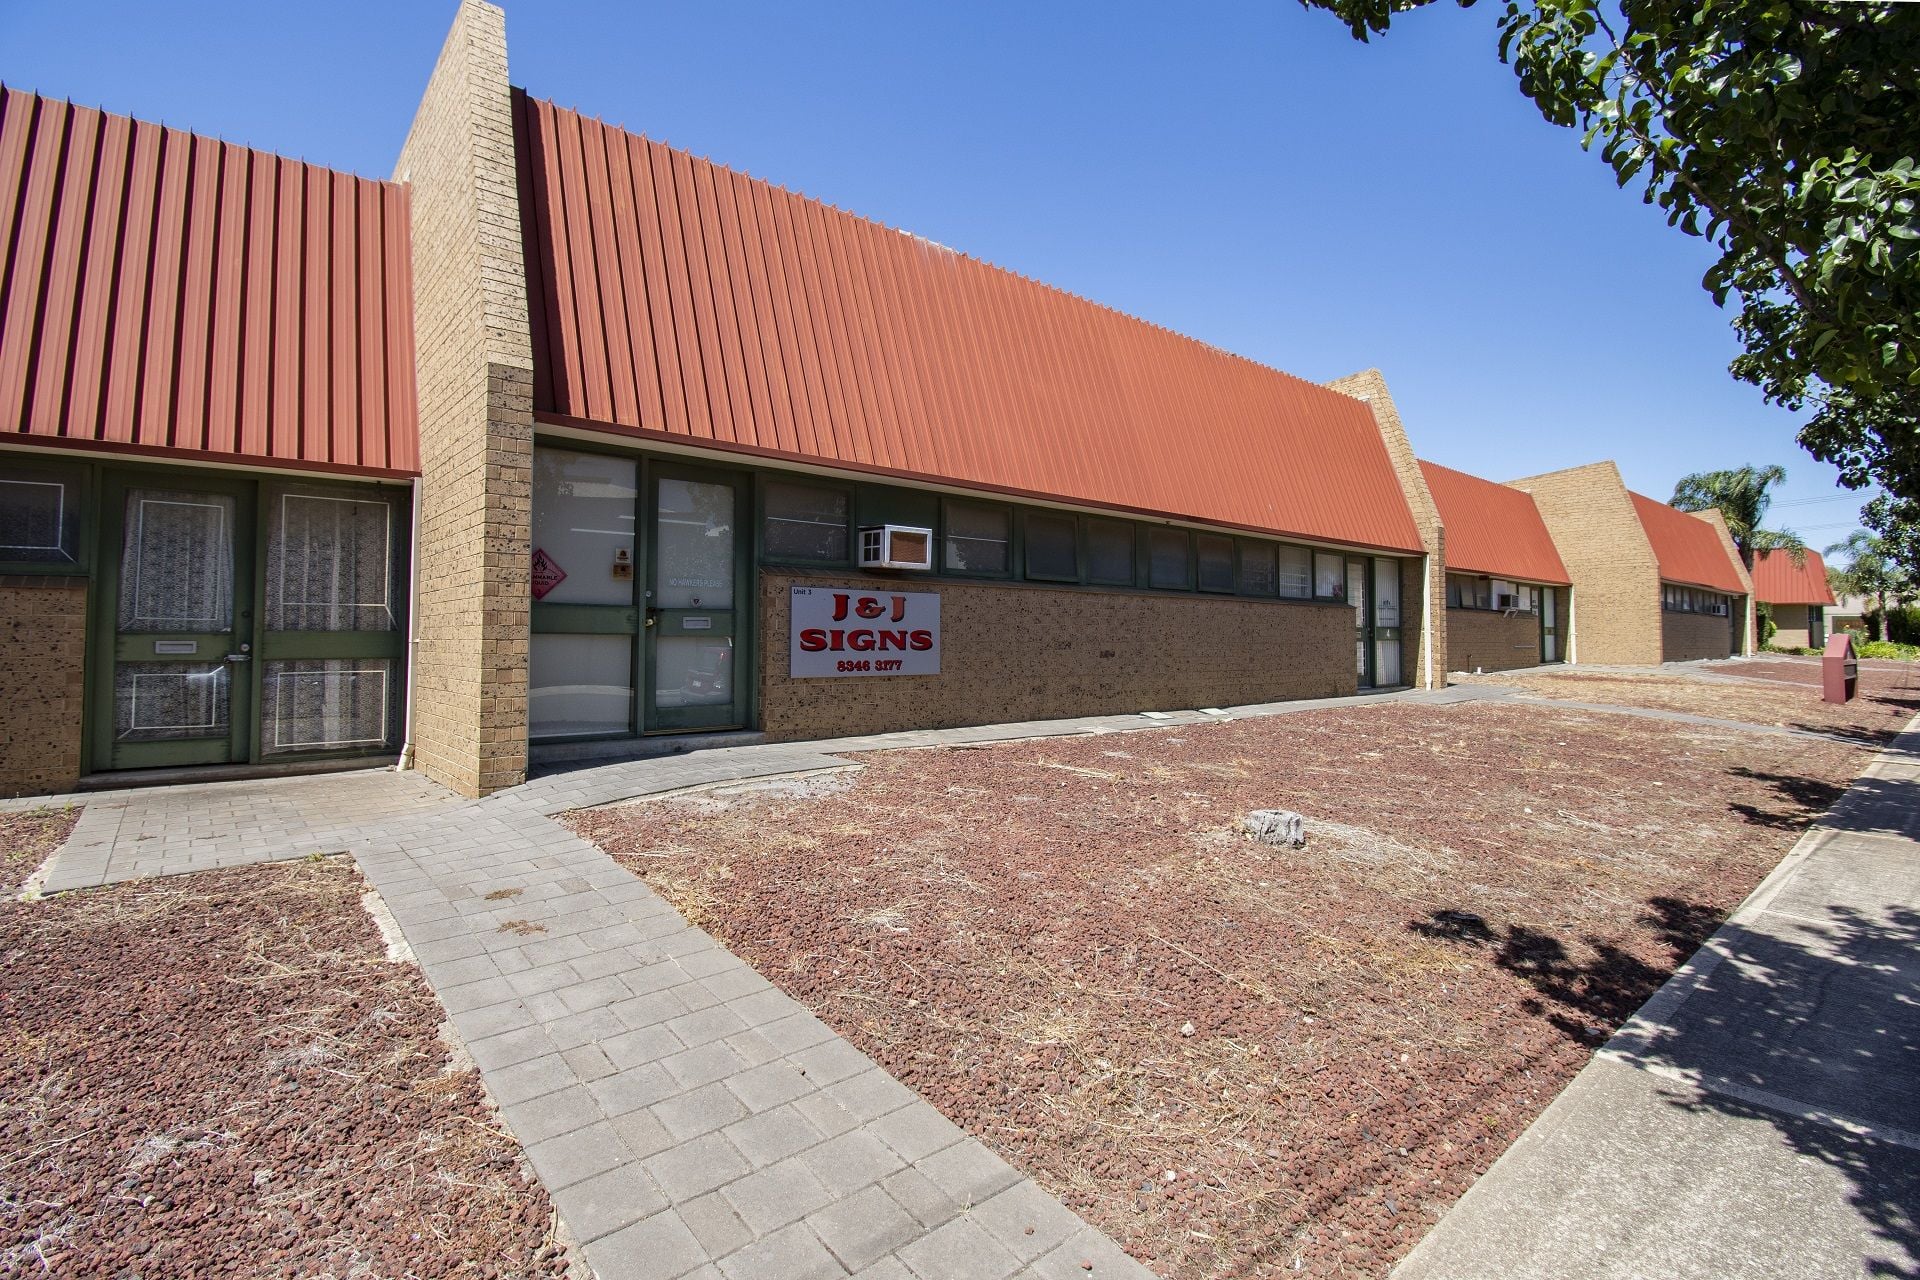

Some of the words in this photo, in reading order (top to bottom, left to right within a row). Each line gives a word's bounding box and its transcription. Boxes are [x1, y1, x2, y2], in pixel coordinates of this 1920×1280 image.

[832, 594, 850, 622] J
[855, 597, 886, 619] &
[890, 596, 906, 622] J
[799, 628, 933, 652] SIGNS
[837, 660, 871, 672] 8346
[875, 659, 903, 671] 3177
